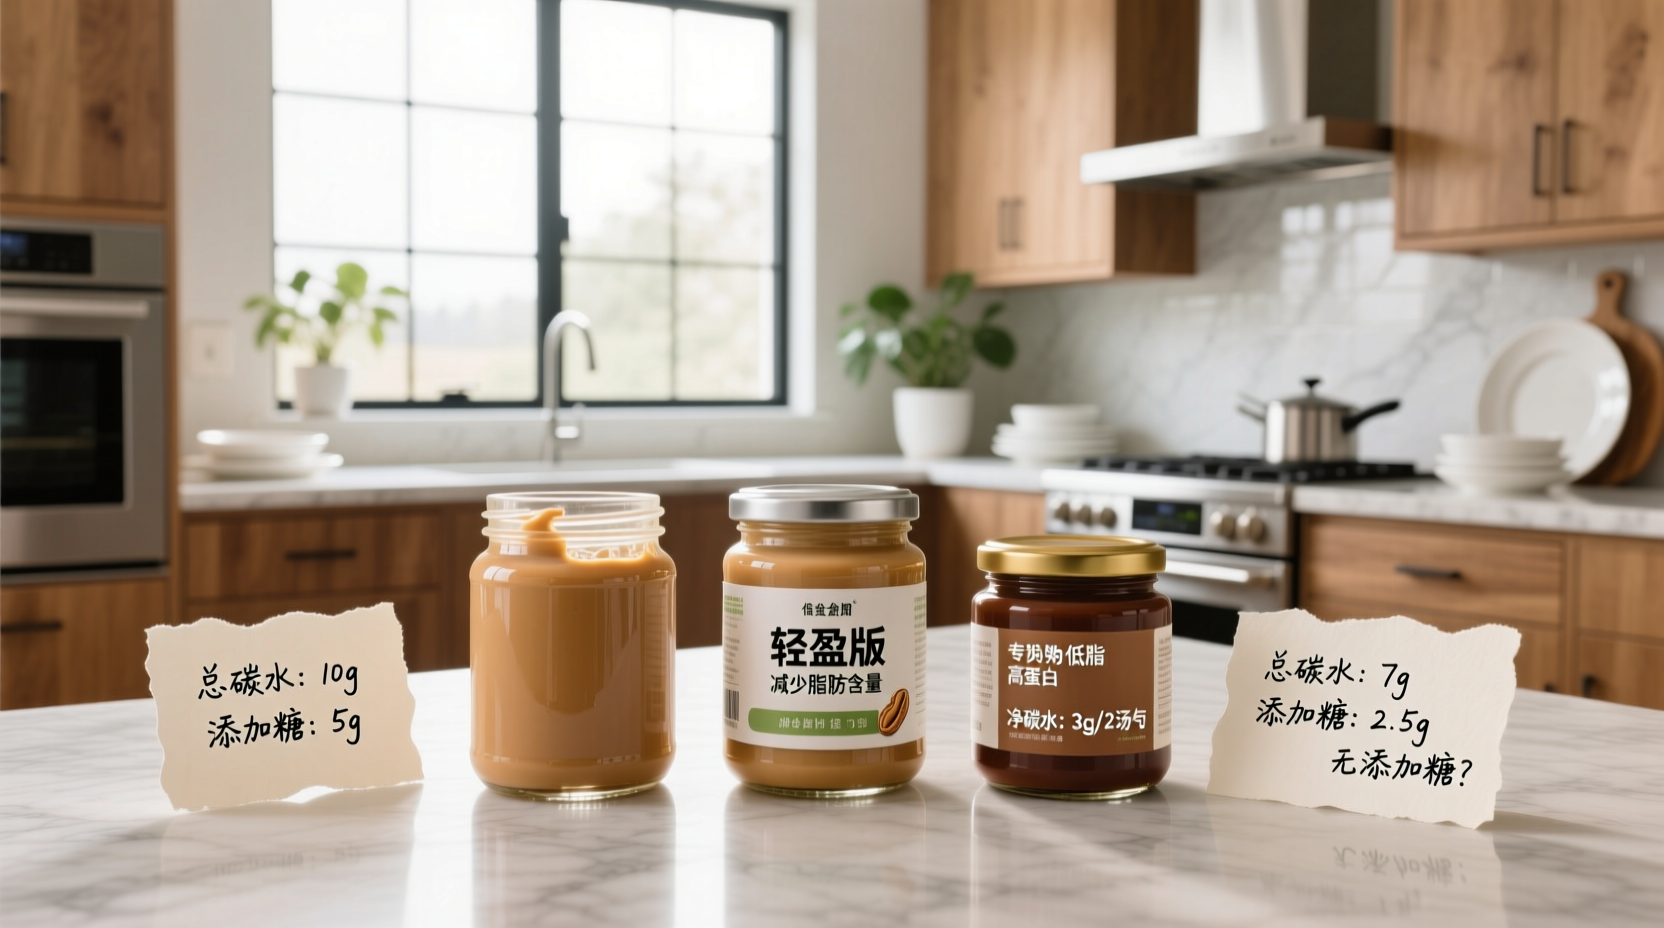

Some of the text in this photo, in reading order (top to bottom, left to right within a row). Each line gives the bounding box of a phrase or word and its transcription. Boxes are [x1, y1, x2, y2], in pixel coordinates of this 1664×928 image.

[770, 625, 886, 668] 轻盈版
[1007, 664, 1059, 688] 高蛋白
[1331, 748, 1473, 787] 无添加糖？
